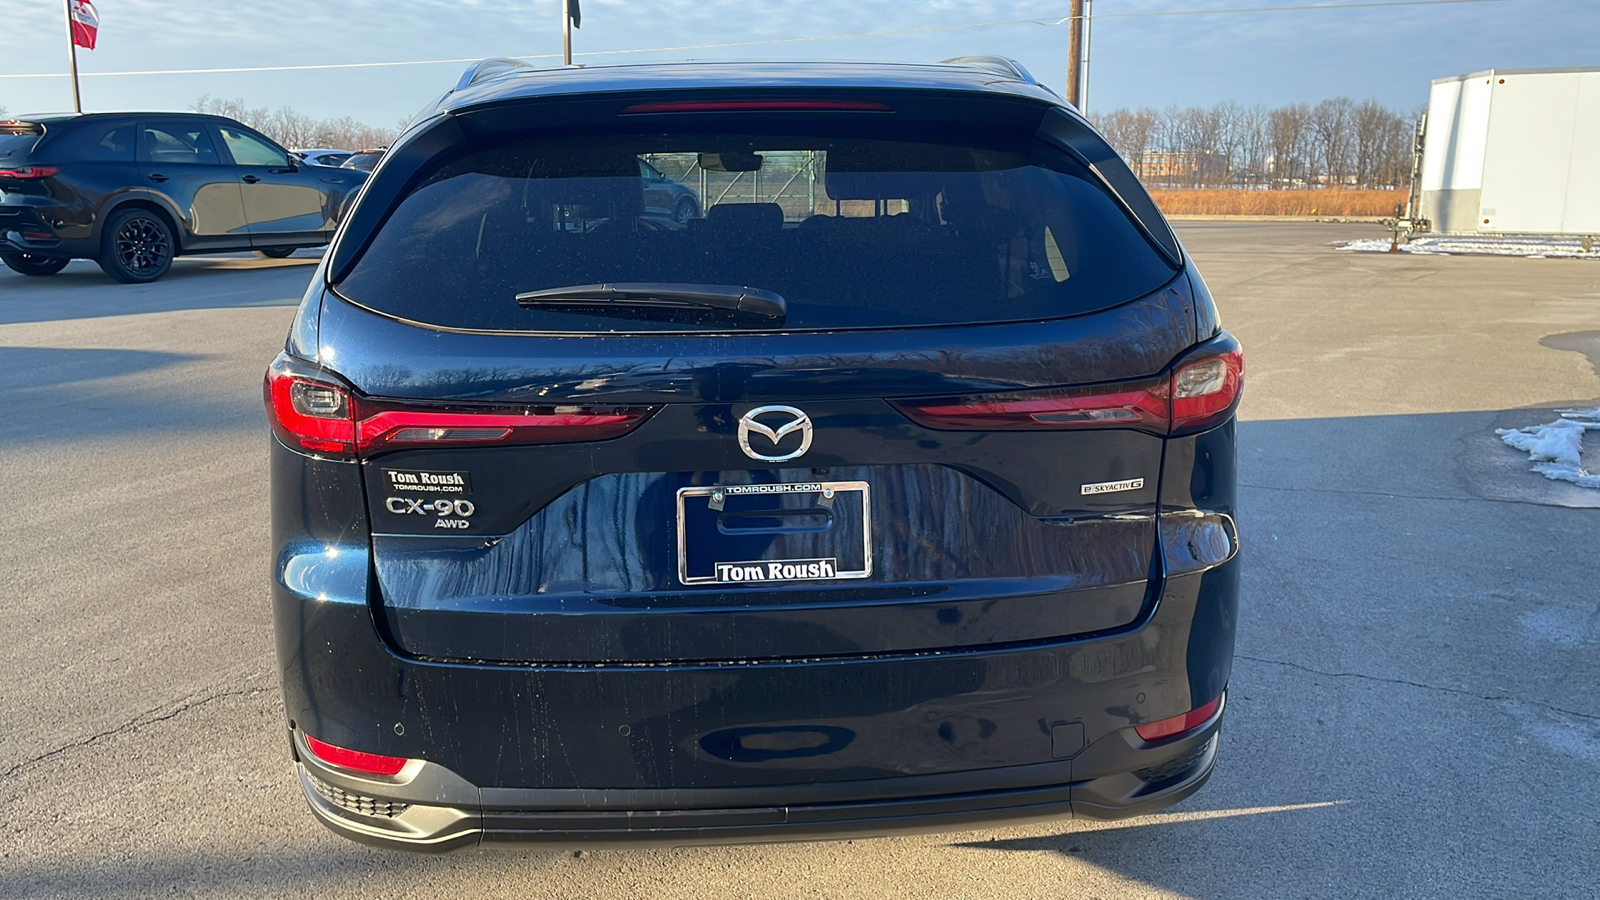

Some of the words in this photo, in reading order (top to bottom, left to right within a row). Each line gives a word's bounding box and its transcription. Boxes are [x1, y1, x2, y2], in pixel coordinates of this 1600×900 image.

[388, 471, 418, 483] Tom
[420, 473, 464, 484] Roush
[393, 484, 463, 492] TOMROUSH.COM
[727, 484, 822, 493] TOMROUSH.COM
[386, 497, 475, 517] CX-90
[434, 519, 470, 529] AWD
[718, 564, 764, 581] Tom
[767, 561, 834, 580] Roush
